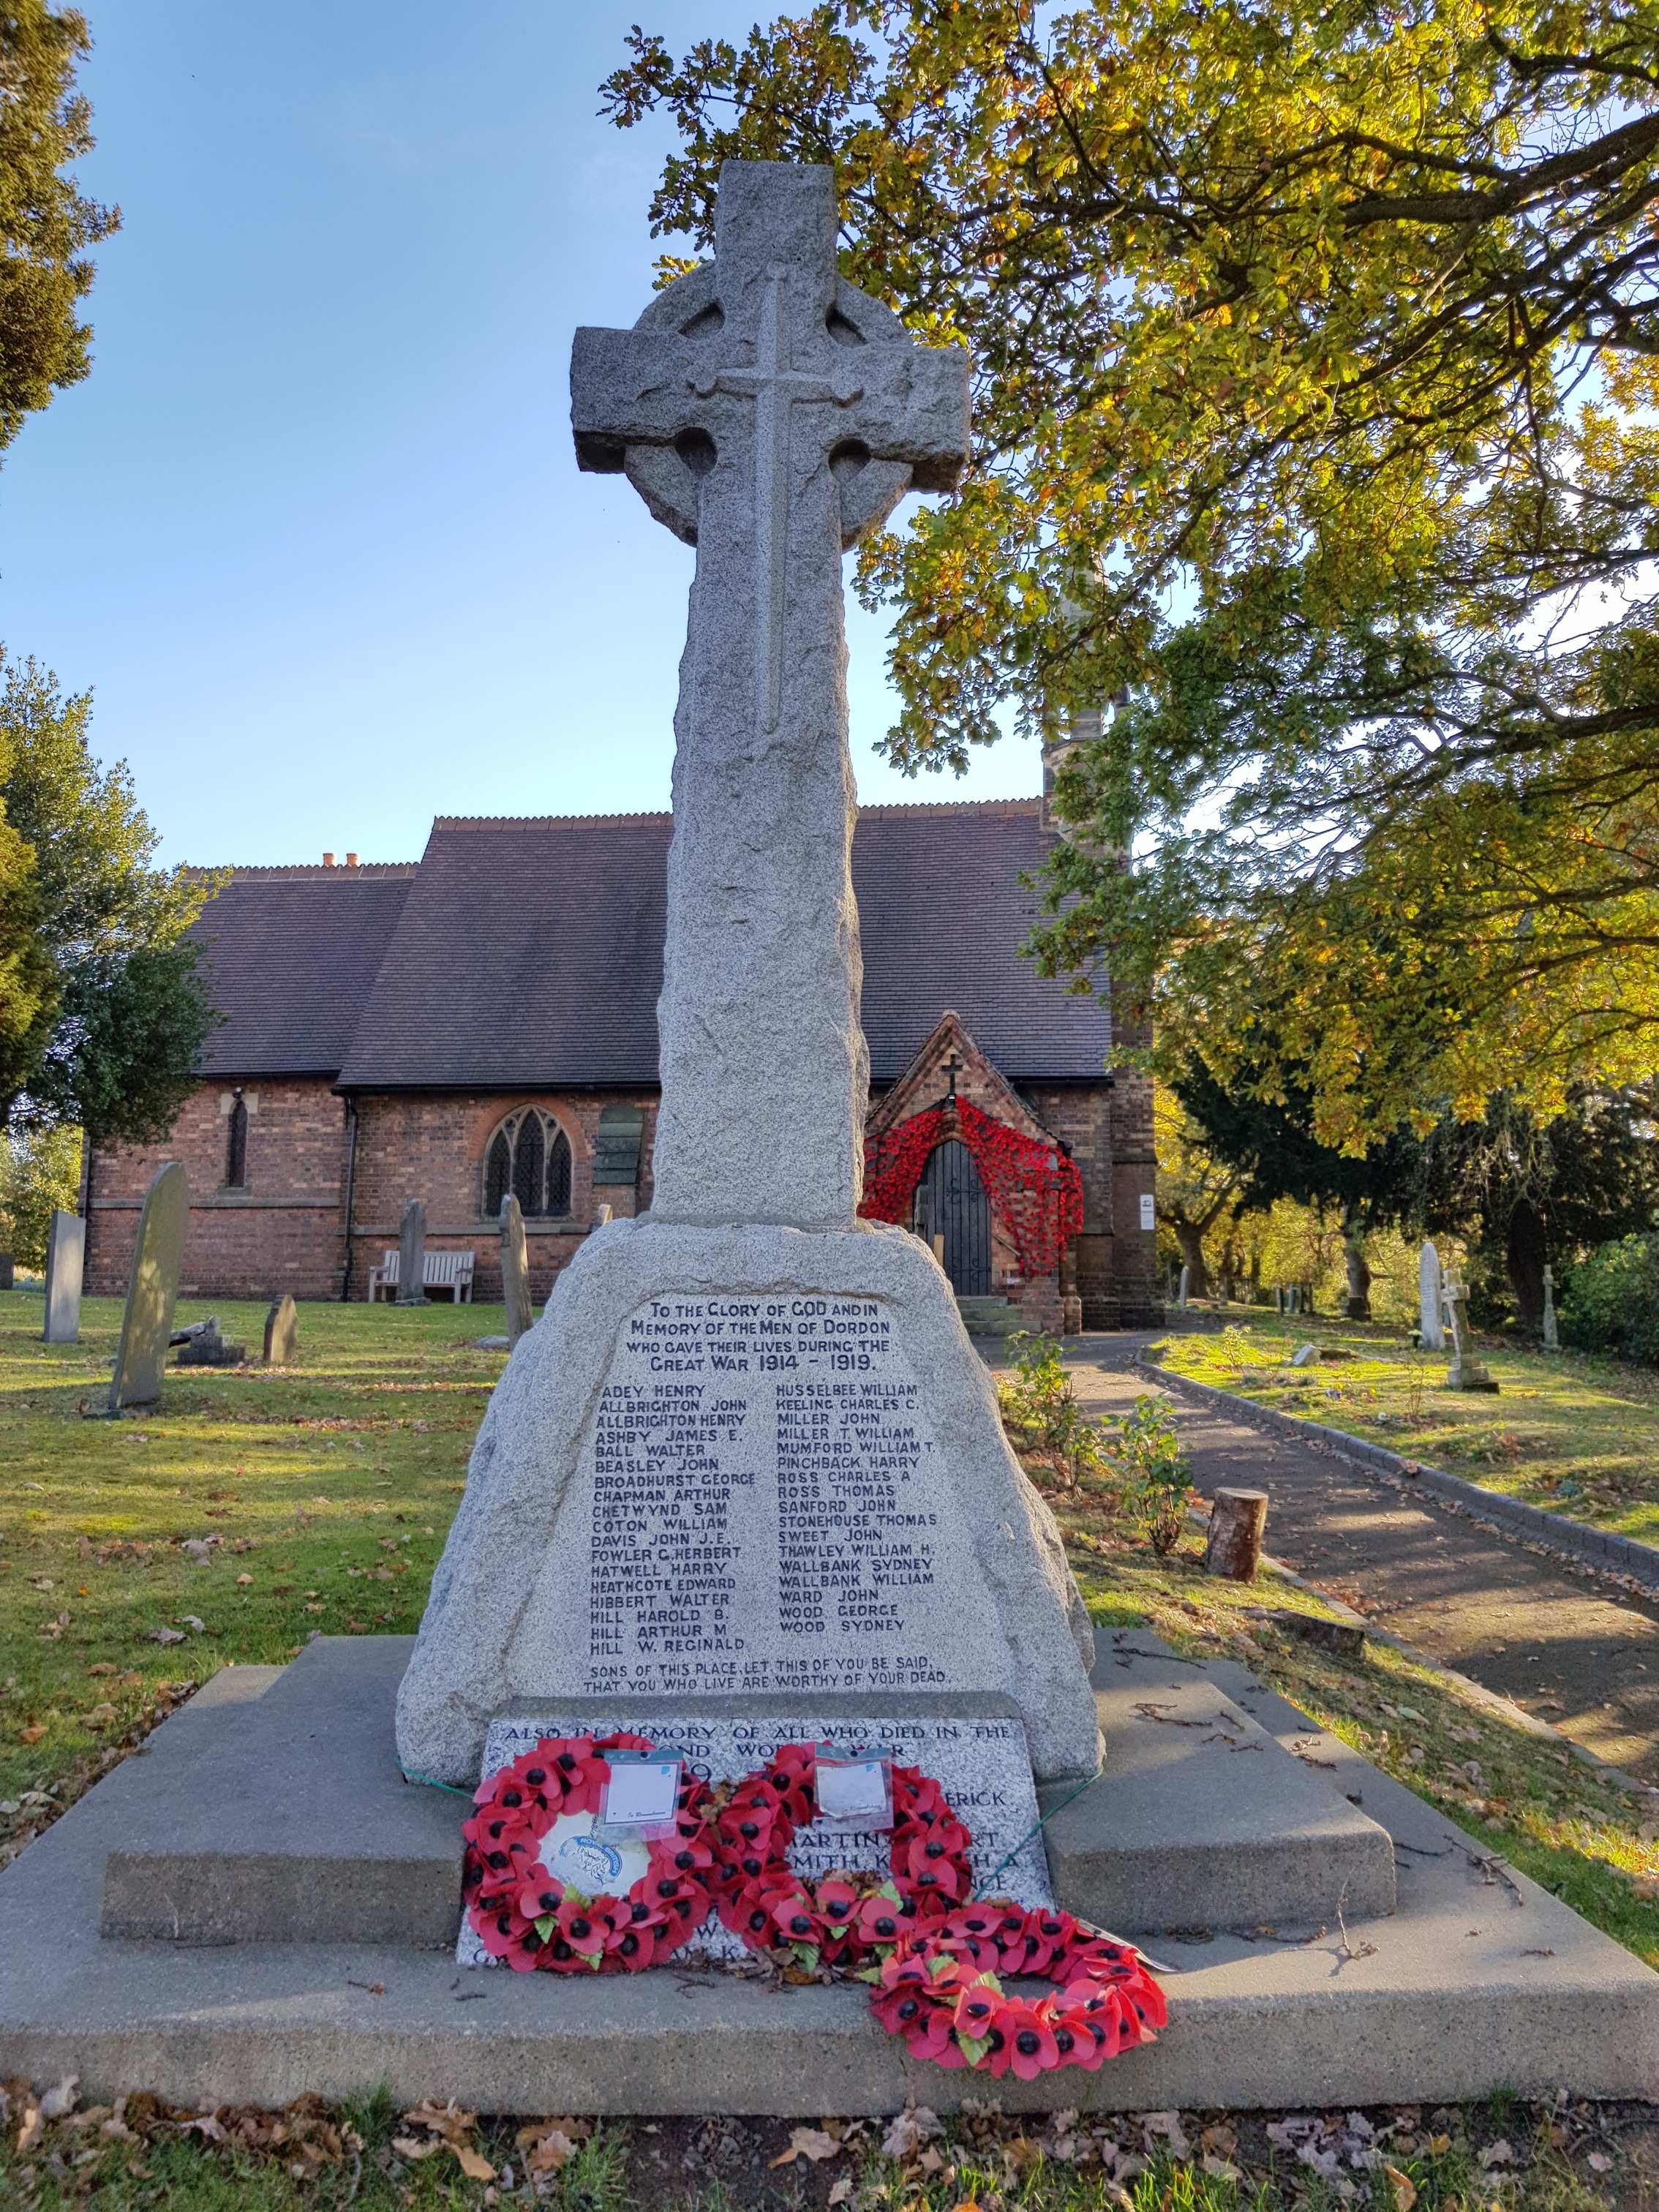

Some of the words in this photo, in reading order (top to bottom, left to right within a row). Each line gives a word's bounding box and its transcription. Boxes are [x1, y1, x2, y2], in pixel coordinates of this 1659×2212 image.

[674, 1305, 704, 1317] THE
[707, 1301, 761, 1317] GLORY
[767, 1304, 787, 1317] OF
[791, 1301, 827, 1317] GOD
[631, 1320, 701, 1336] MEMORY
[704, 1323, 726, 1335] OF
[729, 1323, 757, 1335] THE
[759, 1320, 793, 1335] MEN
[797, 1322, 818, 1335] OF
[823, 1319, 890, 1334] DORDON
[626, 1342, 661, 1353] WHO
[664, 1342, 703, 1354] GAVE
[707, 1341, 748, 1353] THEIR
[753, 1341, 793, 1353] LIVES
[797, 1340, 854, 1353] DURING
[858, 1339, 890, 1353] THE
[650, 1355, 706, 1372] GREAT
[710, 1355, 749, 1372] WAR
[759, 1354, 800, 1372] 1914
[830, 1354, 877, 1371] 1919.
[601, 1385, 644, 1399] ADEY
[654, 1385, 706, 1398] HENRY
[775, 1383, 857, 1397] HUSSELBEE
[859, 1383, 918, 1396] WILLIAM
[598, 1399, 700, 1413] ALLBRIGHTON
[710, 1399, 747, 1412] JOHN
[775, 1399, 833, 1411] KEELING
[840, 1399, 900, 1411] CHARLES
[595, 1414, 696, 1429] ALLBRIGHTON
[699, 1413, 747, 1427] HENRY
[777, 1412, 830, 1426] MILLER
[840, 1412, 880, 1426] JOHN
[595, 1430, 652, 1445] ASHBY
[665, 1429, 718, 1442] JAMES
[777, 1427, 830, 1440] MILLER
[854, 1426, 914, 1440] WILLIAM
[595, 1445, 633, 1458] BALL
[645, 1444, 705, 1457] WALTER
[776, 1442, 853, 1455] MUMFORD
[859, 1441, 921, 1453] WILLIAM
[595, 1459, 666, 1473] BEASLEY
[677, 1459, 719, 1472] JOHN
[778, 1456, 862, 1470] PINCHBACK
[869, 1456, 920, 1468] HARRY
[594, 1475, 696, 1489] BROADHURST
[701, 1472, 756, 1486] GEORGE
[778, 1472, 819, 1484] ROSS
[827, 1470, 892, 1483] CHARLES
[593, 1489, 666, 1502] CHAPMAN
[673, 1488, 731, 1501] ARTHUR
[778, 1485, 821, 1499] ROSS
[832, 1484, 895, 1497] THOMAS
[592, 1503, 681, 1519] CHETWYND
[693, 1502, 728, 1516] SAM
[778, 1500, 848, 1514] SANFORD
[857, 1499, 896, 1513] JOHN
[592, 1519, 648, 1533] COTON
[663, 1518, 728, 1531] WILLIAM
[778, 1514, 870, 1528] STONEHOUSE
[876, 1513, 937, 1527] THOMAS
[591, 1535, 637, 1548] DAVIS
[648, 1532, 690, 1546] JOHN
[778, 1530, 830, 1543] SWEET
[843, 1529, 882, 1541] JOHN
[591, 1549, 652, 1563] FOWLER
[778, 1544, 846, 1558] THAWLEY
[851, 1543, 912, 1557] WILLIAM
[590, 1564, 661, 1579] HATWELL
[671, 1562, 728, 1576] HARRY
[779, 1559, 862, 1573] WALLBANK
[871, 1557, 933, 1572] SYDNEY
[590, 1579, 673, 1594] HEATHCOTE
[677, 1578, 737, 1591] EDWARD
[779, 1574, 862, 1589] WALLBANK
[873, 1573, 934, 1587] WILLIAM
[590, 1595, 658, 1610] HIBBERT
[669, 1593, 730, 1607] WALTER
[779, 1590, 823, 1604] WARD
[838, 1589, 879, 1603] JOHN
[590, 1611, 624, 1625] HILL
[636, 1609, 701, 1623] HAROLD
[778, 1606, 824, 1619] WOOD
[838, 1603, 898, 1617] GEORGE
[590, 1627, 624, 1640] HILL
[636, 1625, 703, 1639] ARTHUR
[713, 1624, 728, 1636] M
[780, 1621, 826, 1633] WOOD
[840, 1620, 905, 1632] SYDNEY
[590, 1641, 624, 1656] HILL
[663, 1639, 745, 1652] REGINALD
[590, 1665, 628, 1678] SONS
[635, 1665, 652, 1677] OF
[658, 1663, 691, 1677] THIS
[775, 1659, 808, 1673] THIS
[812, 1658, 830, 1671] OF
[835, 1658, 865, 1671] YOU
[871, 1657, 889, 1670] BE
[583, 1681, 622, 1694] THAT
[627, 1679, 656, 1692] YOU
[663, 1678, 697, 1691] WHO
[704, 1677, 735, 1690] LIVE
[742, 1676, 770, 1690] ARE
[775, 1674, 839, 1688] WORTHY
[843, 1673, 863, 1686] OF
[868, 1671, 905, 1685] YOUR
[505, 1727, 561, 1740] ALSO
[732, 1726, 760, 1739] OF
[773, 1726, 810, 1739] ALL
[820, 1726, 868, 1739] WHO
[880, 1726, 925, 1739] DIED
[936, 1726, 959, 1739] IN
[969, 1726, 1010, 1739] THE
[944, 1791, 1007, 1807] ERICK
